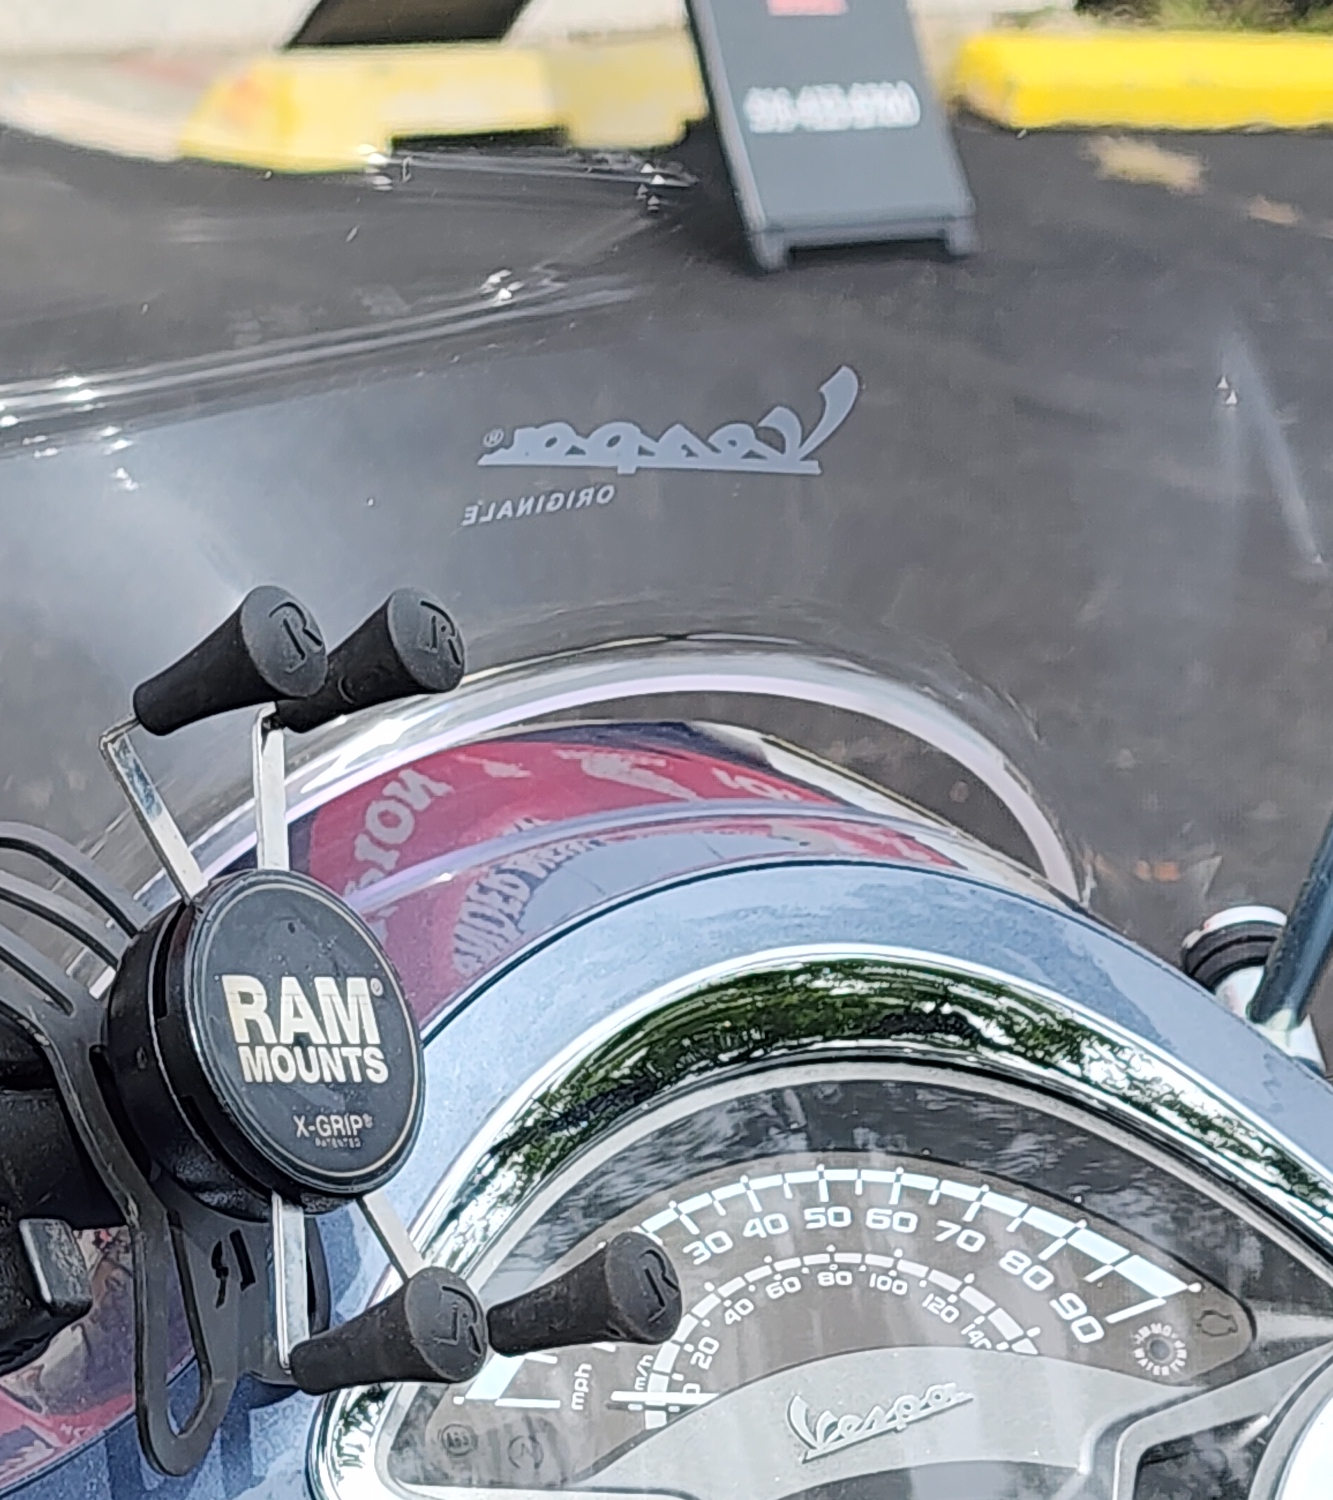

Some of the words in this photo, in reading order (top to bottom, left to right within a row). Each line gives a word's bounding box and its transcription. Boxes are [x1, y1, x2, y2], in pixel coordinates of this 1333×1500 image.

[238, 1045, 389, 1084] MOUNTS
[743, 1213, 789, 1238] 40
[804, 1206, 852, 1230] 50
[866, 1208, 918, 1234] 60
[683, 1231, 733, 1265] 30
[935, 1219, 986, 1252] 70
[817, 1271, 853, 1286] 80
[869, 1273, 908, 1296] 100
[999, 1250, 1055, 1291] 80
[765, 1276, 802, 1299] 60
[724, 1299, 754, 1325] 40
[922, 1293, 959, 1324] 120
[1050, 1292, 1105, 1343] 90
[690, 1336, 719, 1369] 20
[1133, 1347, 1170, 1376] WATER
[571, 1363, 593, 1410] mph
[787, 1382, 974, 1464] Vespa
